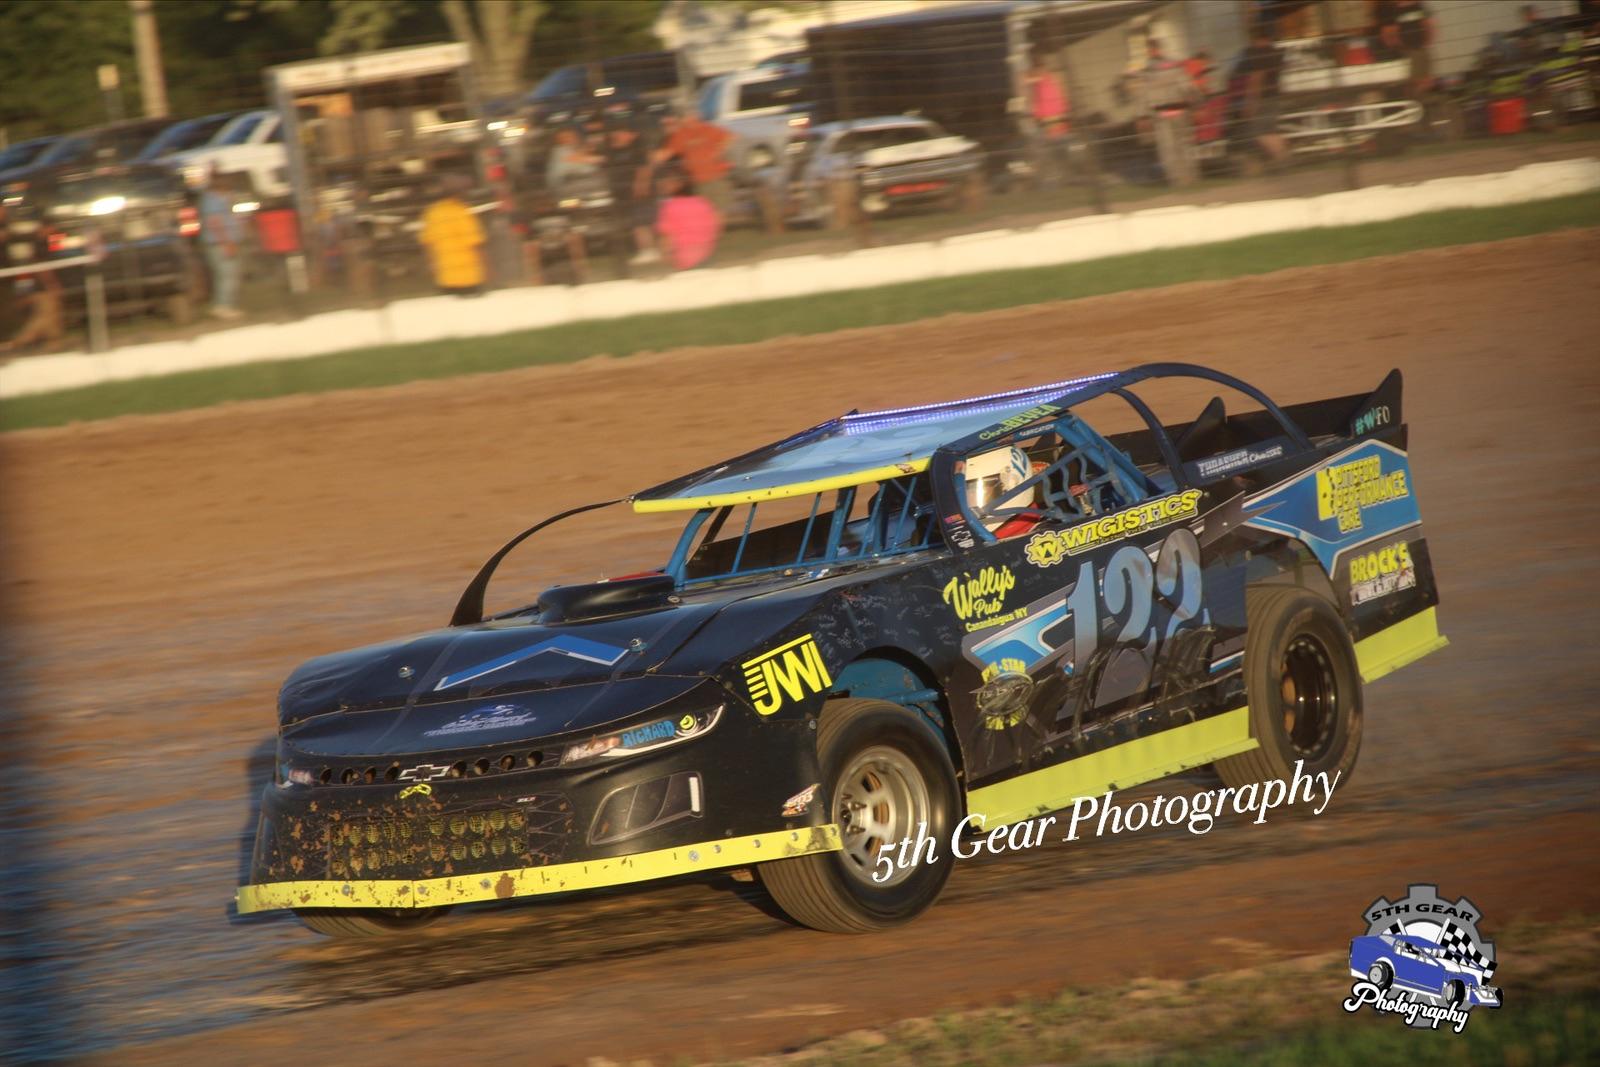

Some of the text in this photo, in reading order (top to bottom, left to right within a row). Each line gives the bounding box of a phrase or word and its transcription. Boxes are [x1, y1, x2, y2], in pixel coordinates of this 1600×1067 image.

[1060, 490, 1202, 549] WIGISTICS
[1350, 541, 1409, 585] BROCK'S
[943, 565, 1015, 619] Wally's
[973, 598, 1003, 618] Pub
[1013, 607, 1028, 619] NY
[1063, 528, 1212, 712] 122
